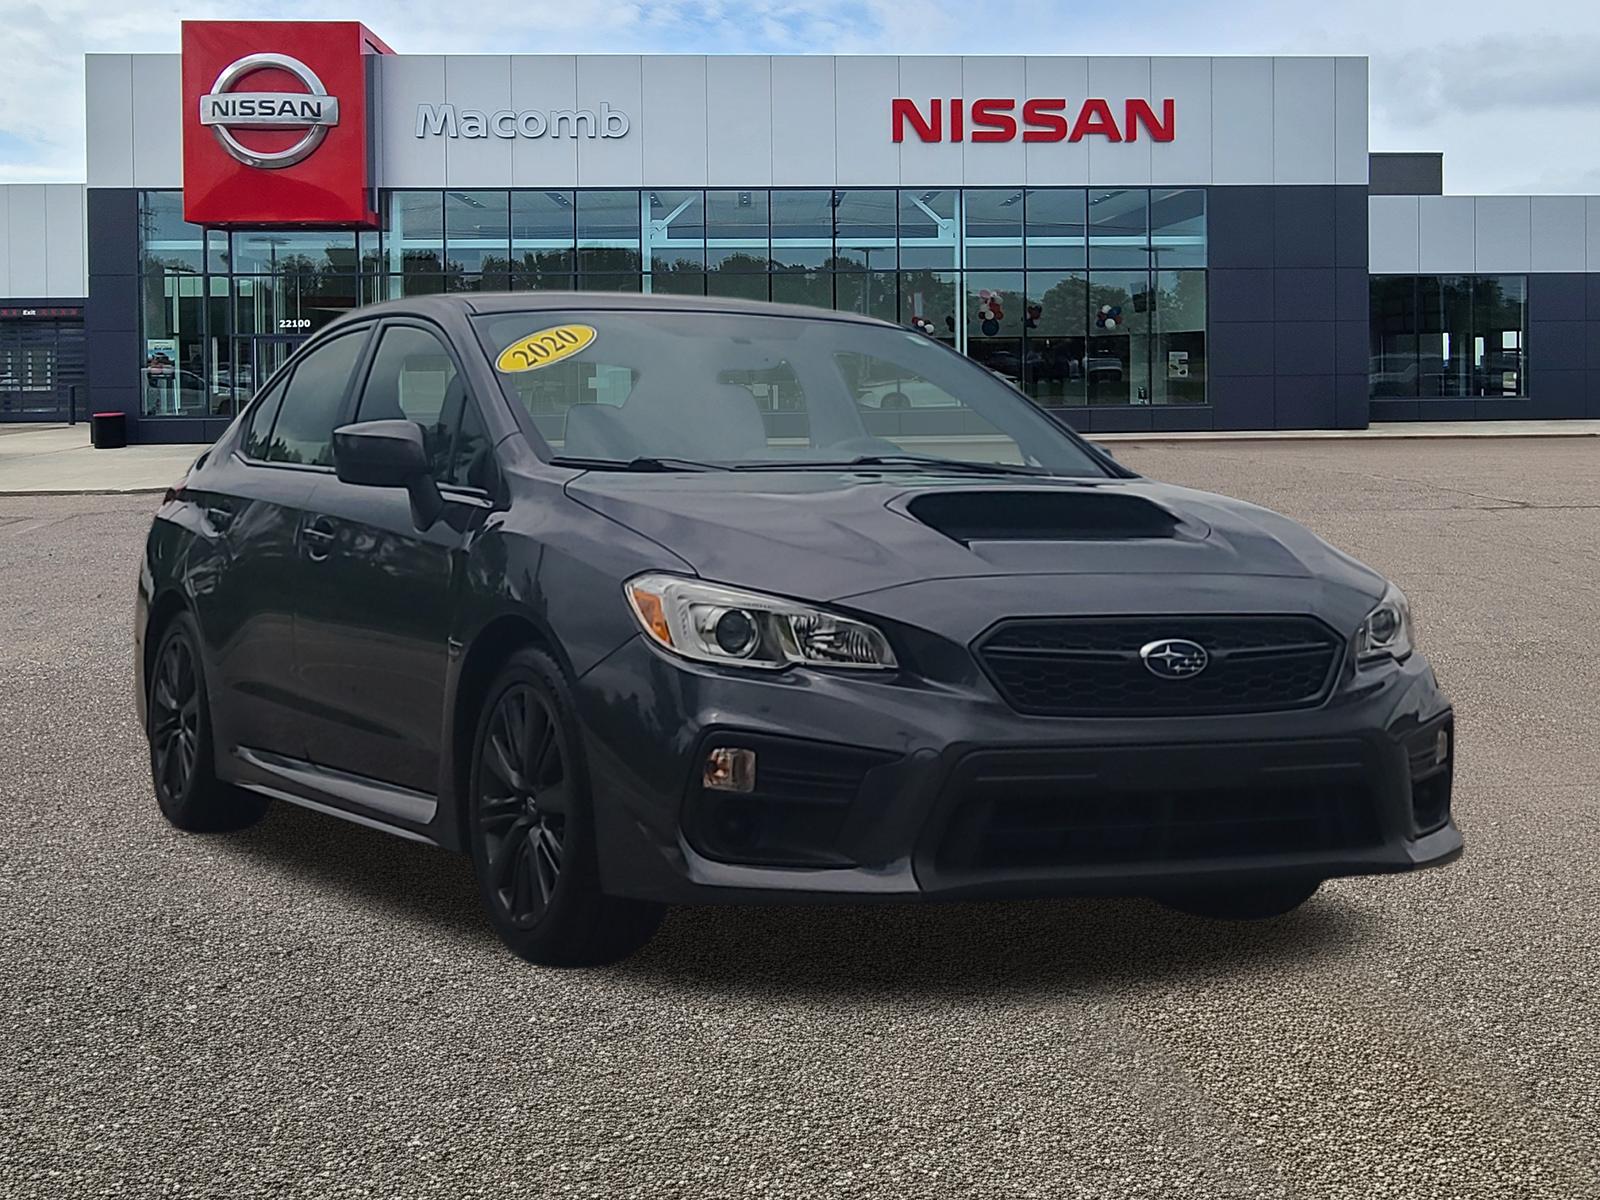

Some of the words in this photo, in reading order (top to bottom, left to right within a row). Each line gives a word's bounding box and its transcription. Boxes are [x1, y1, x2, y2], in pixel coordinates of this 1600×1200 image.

[212, 100, 322, 118] NISSAN
[415, 102, 630, 139] Macomb
[892, 98, 1176, 143] NISSAN
[279, 319, 311, 328] 22100
[512, 329, 579, 367] 2020
